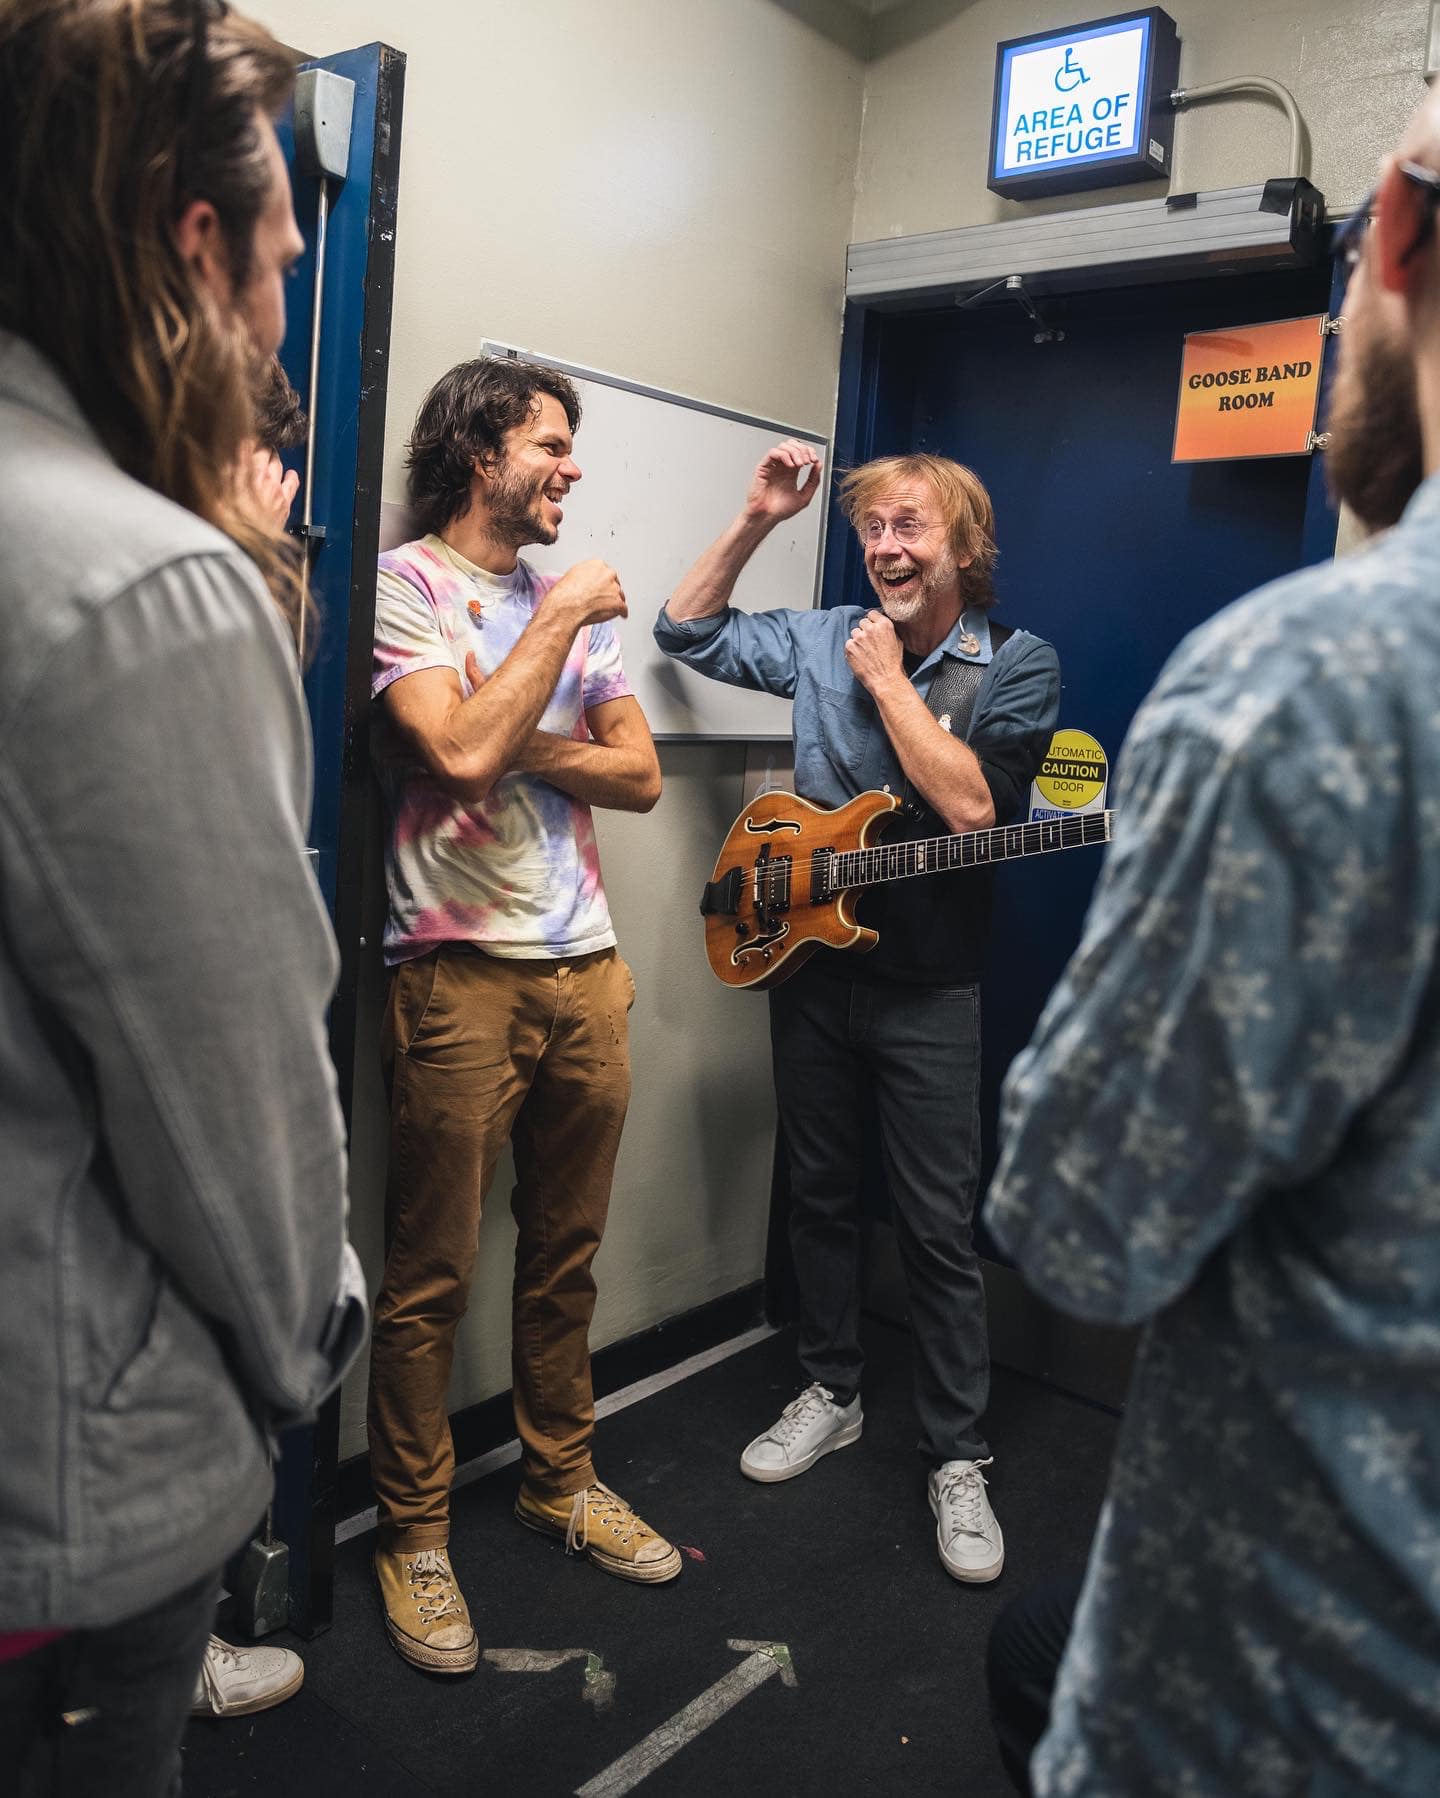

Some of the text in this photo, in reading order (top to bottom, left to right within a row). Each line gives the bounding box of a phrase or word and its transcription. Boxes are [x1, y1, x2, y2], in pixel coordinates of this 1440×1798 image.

[1013, 93, 1130, 137] AREA OF
[1016, 123, 1122, 163] REFUGE
[1188, 361, 1312, 390] GOOSE BAND
[1218, 391, 1275, 412] ROOM
[1048, 746, 1102, 760] UTOMATIC
[1041, 762, 1099, 779] CAUTION
[1053, 780, 1084, 793] DOOR
